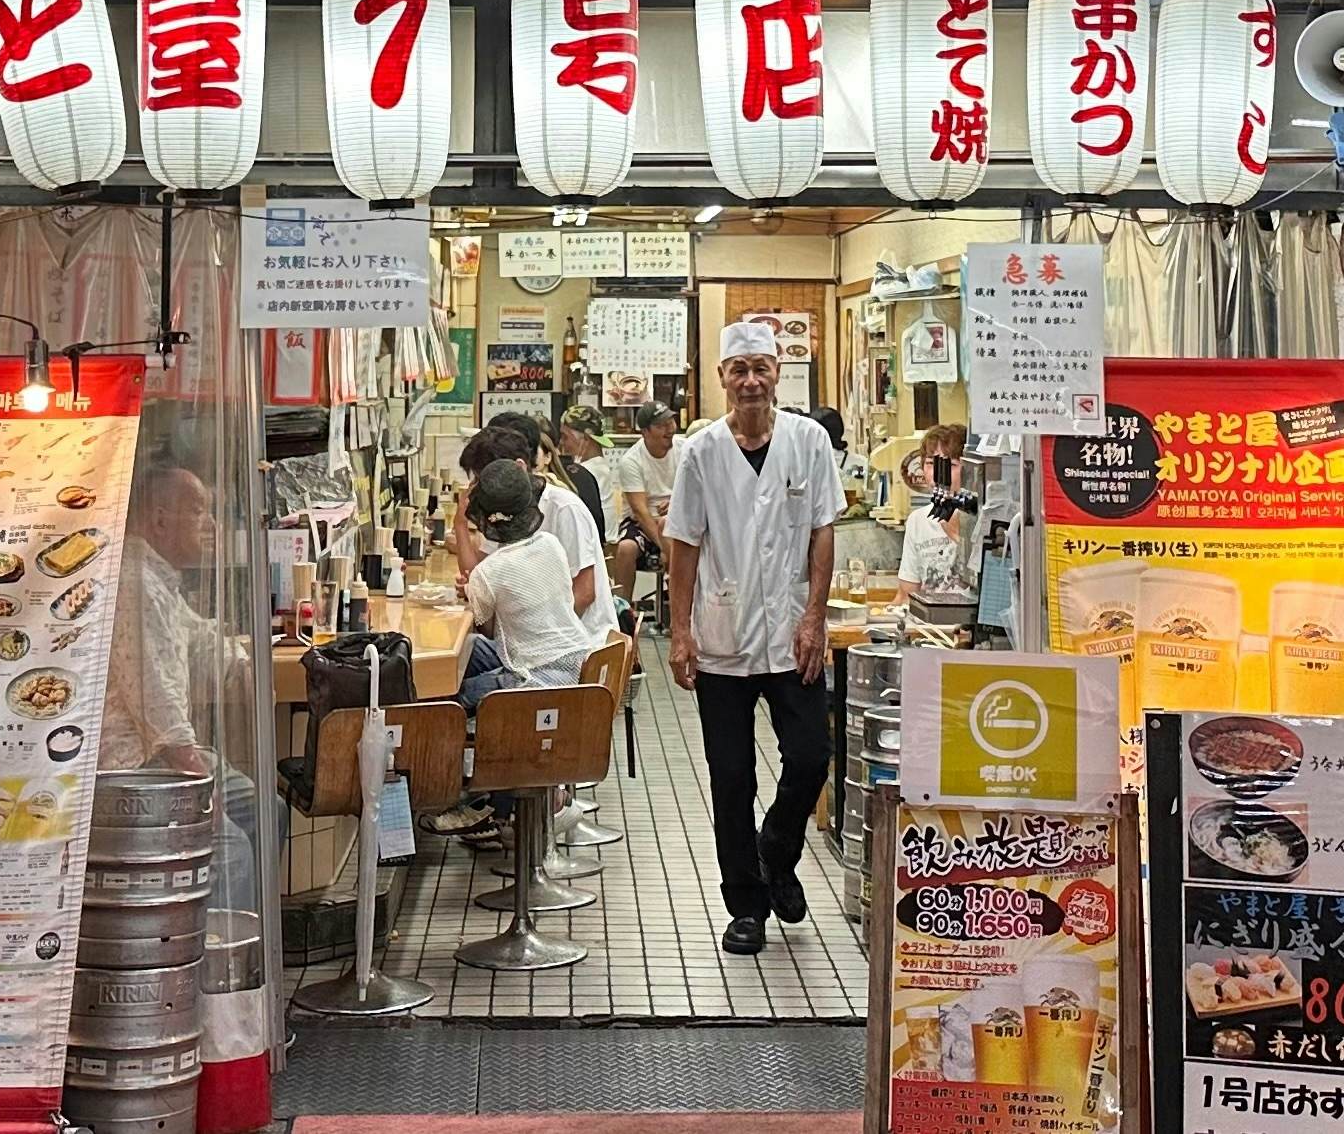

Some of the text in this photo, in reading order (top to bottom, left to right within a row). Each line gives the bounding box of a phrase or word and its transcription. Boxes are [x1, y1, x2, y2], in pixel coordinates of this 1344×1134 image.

[263, 255, 407, 270] お気軽にお入り下さい
[1002, 253, 1065, 285] 急募
[55, 392, 92, 412] 메뉴
[1153, 410, 1280, 448] やまと屋
[1079, 442, 1134, 466] 名物!
[1157, 489, 1240, 503] YAMATOYA
[1242, 490, 1297, 506] Original
[542, 713, 552, 726] 4
[979, 765, 1037, 783] 喫煙OK
[901, 816, 1068, 876] 飲み放題
[917, 887, 1044, 915] 60分 1,100円
[916, 913, 962, 938] 90分
[102, 982, 162, 1004] KIRIN
[1038, 1008, 1082, 1022] 一番搾り
[984, 1025, 1023, 1039] 一番搾り
[1085, 1024, 1111, 1114] キリン一番搾り
